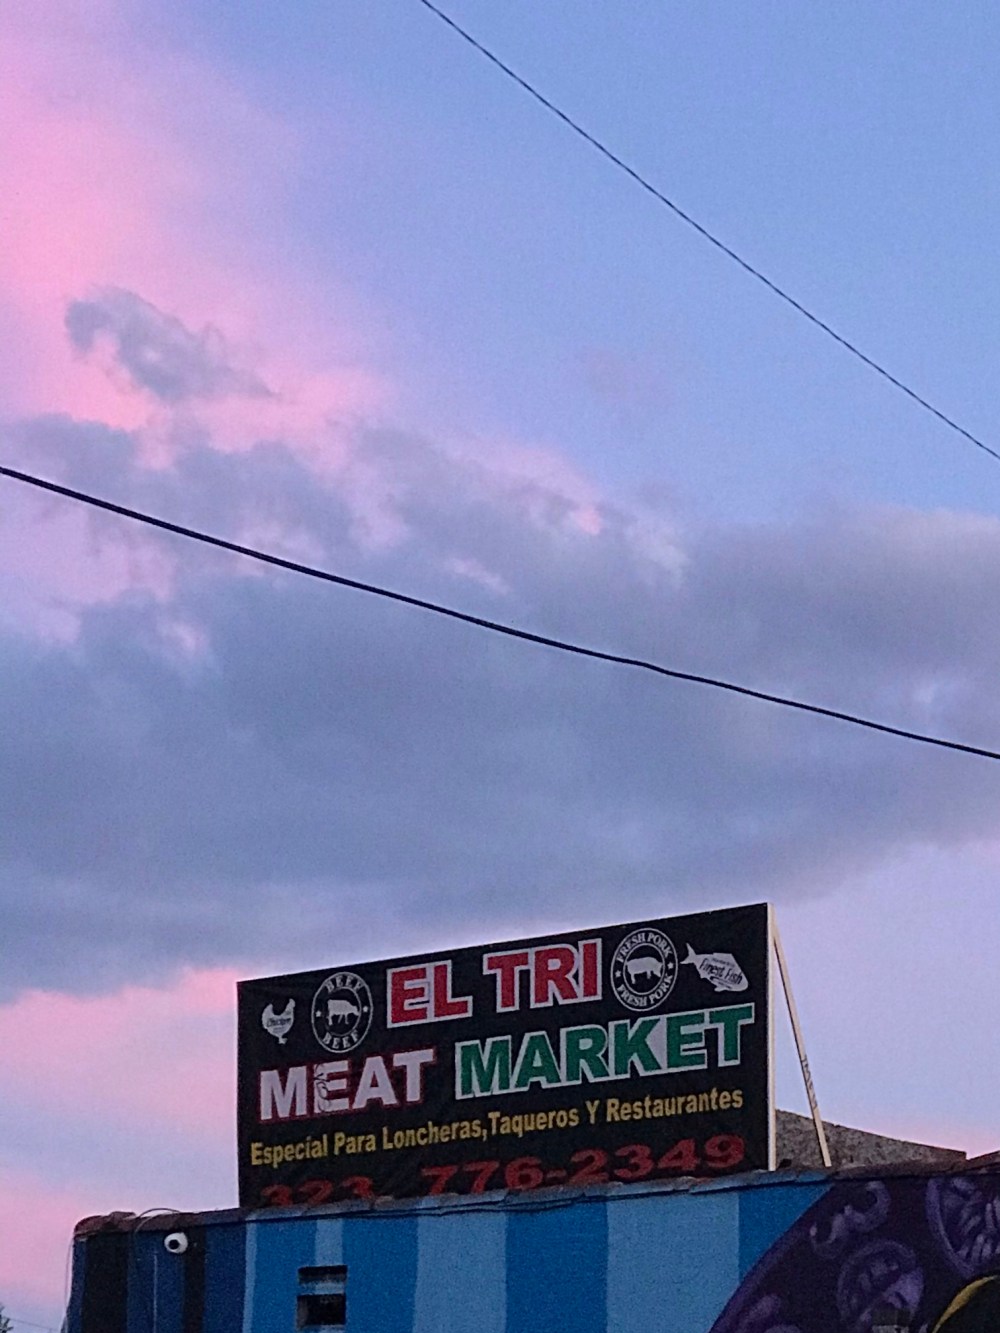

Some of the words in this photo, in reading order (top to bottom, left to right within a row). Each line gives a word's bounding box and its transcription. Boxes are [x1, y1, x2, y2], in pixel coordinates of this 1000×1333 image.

[617, 932, 646, 963] FRESH
[649, 931, 673, 959] PORK
[324, 975, 363, 993] BEEF
[386, 960, 473, 1028] EL
[482, 937, 603, 1014] TRI
[616, 983, 648, 1008] FRESH
[649, 973, 674, 1005] PORK
[322, 1029, 359, 1050] BEEF
[258, 1048, 439, 1123] MEAT
[455, 1003, 755, 1099] MARKET
[250, 1134, 328, 1168] Especial
[334, 1131, 376, 1156] Para
[586, 1099, 600, 1125] Y
[606, 1088, 744, 1122] Restaurantes
